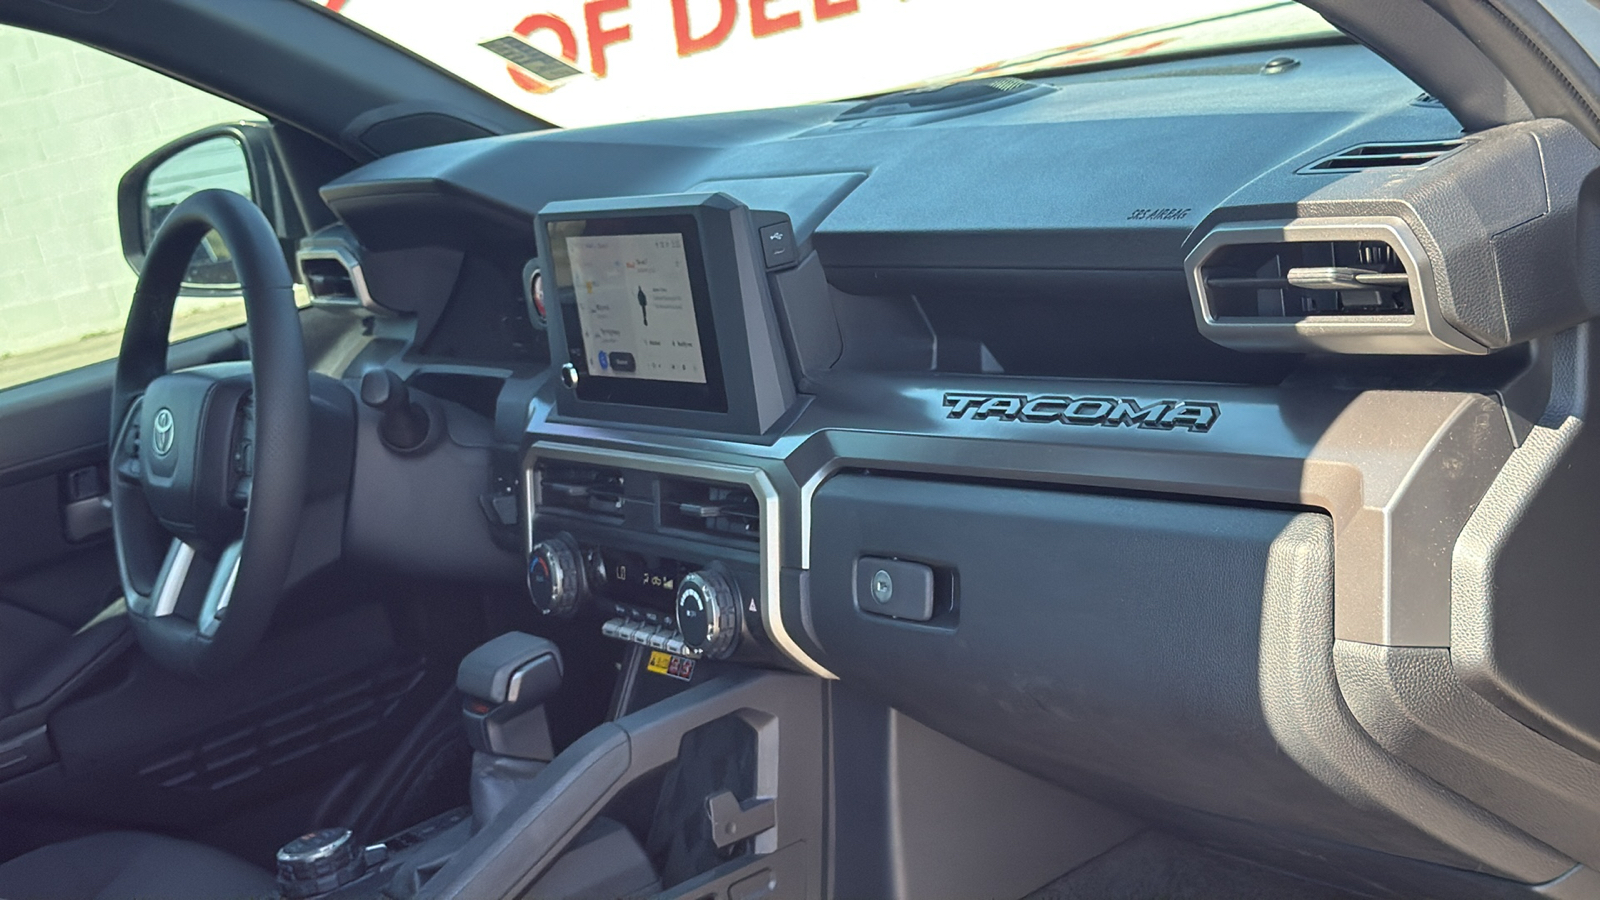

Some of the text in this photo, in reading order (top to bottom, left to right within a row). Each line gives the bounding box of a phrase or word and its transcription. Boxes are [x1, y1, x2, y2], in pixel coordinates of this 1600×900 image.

[507, 0, 860, 95] OF DE
[1145, 208, 1191, 220] AIRBAG
[943, 393, 1221, 433] TACOMA
